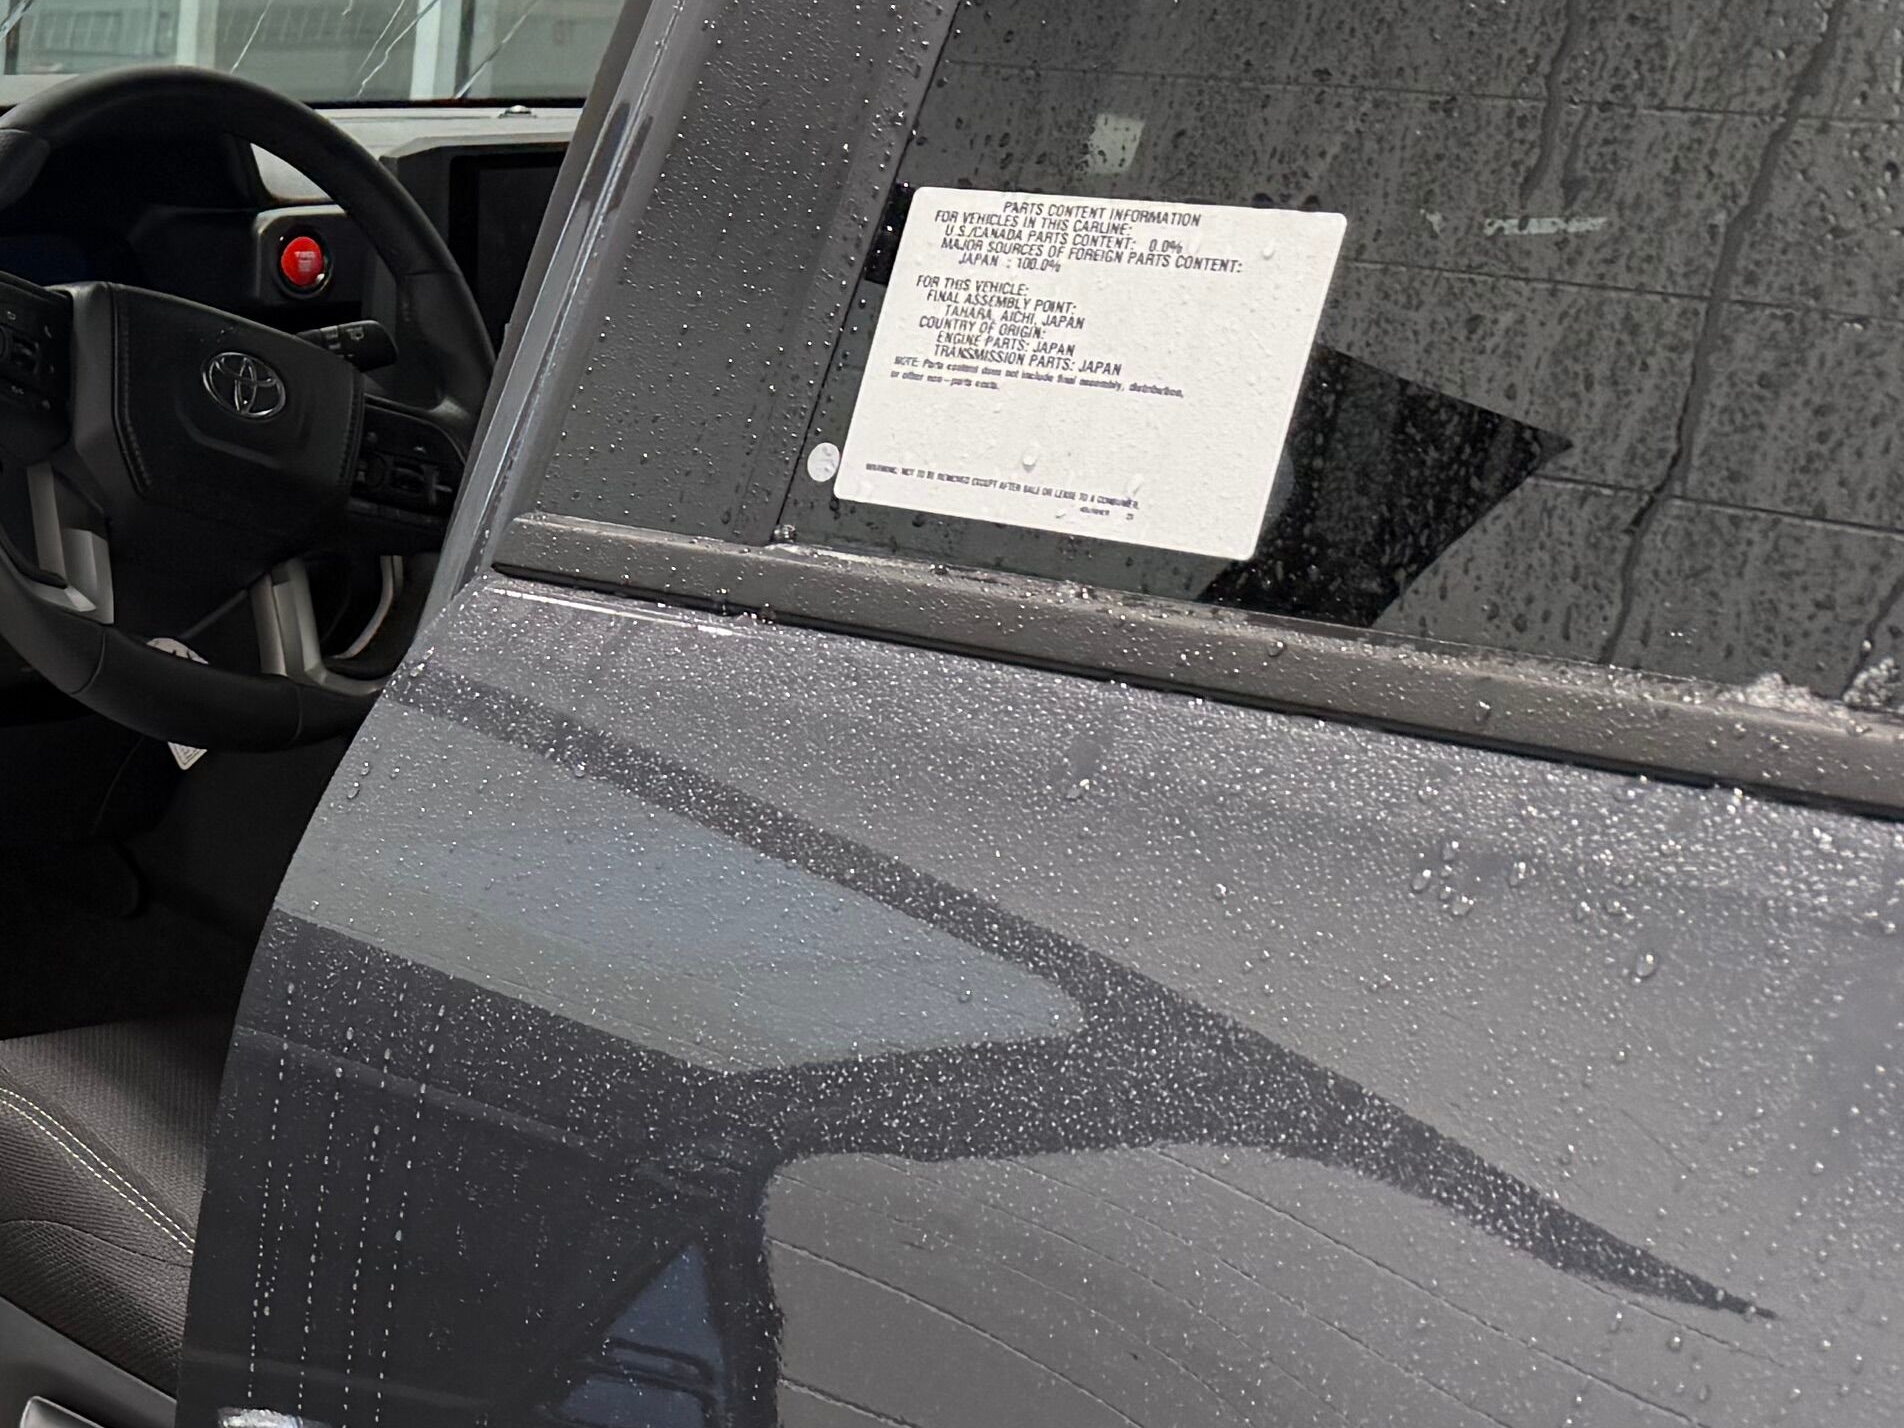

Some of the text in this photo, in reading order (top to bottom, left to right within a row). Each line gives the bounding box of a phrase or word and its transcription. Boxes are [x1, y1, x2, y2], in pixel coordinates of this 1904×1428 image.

[934, 210, 1133, 235] FOR VEHICLES IN THIS CARLINE:
[1003, 201, 1201, 226] PARTS CONTENT INFORMATION
[941, 237, 1243, 273] MAJOR SOURCES OF FOREIGN PARTS CONTENT:
[1027, 231, 1069, 245] PARTS
[1073, 234, 1136, 250] CONTENT:
[1148, 239, 1183, 254] 0.0%
[958, 253, 999, 266] JAPAN
[1017, 257, 1061, 273] 100.0%
[916, 275, 1029, 296] FOR THIS VEHICLE:
[926, 289, 1076, 315] FINAL ASSEMBLY POINT:
[919, 315, 1046, 339] COUNTRY OF ORIGIN:
[1042, 315, 1085, 329] JAPAN
[936, 330, 1076, 357] ENGINE PARTS: JAPAN
[934, 344, 1122, 376] TRANSMISSION PARTS: JAPAN
